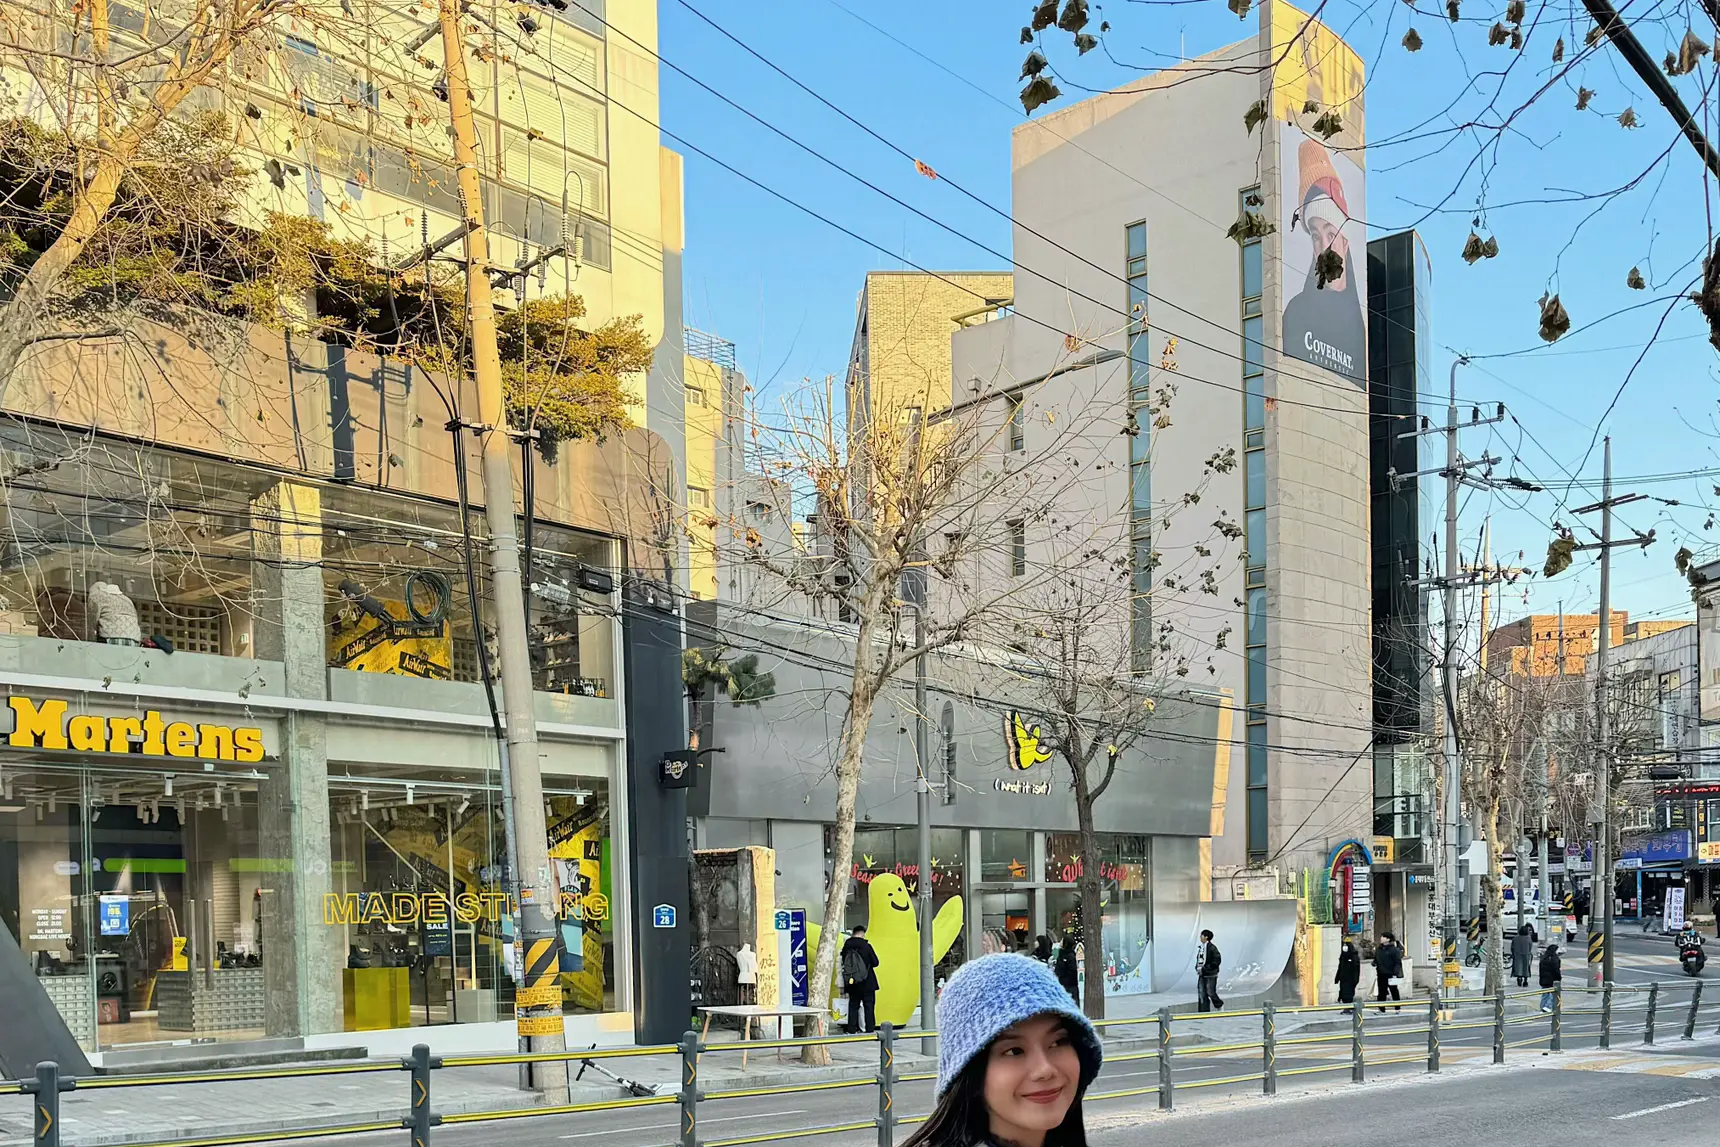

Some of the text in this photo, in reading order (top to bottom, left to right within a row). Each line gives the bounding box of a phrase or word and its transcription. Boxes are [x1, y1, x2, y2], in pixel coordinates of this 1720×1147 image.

[8, 696, 266, 762] Martens
[323, 892, 609, 925] MADE STNG
[660, 915, 670, 925] 28
[778, 920, 787, 929] 26
[426, 922, 449, 930] SALE
